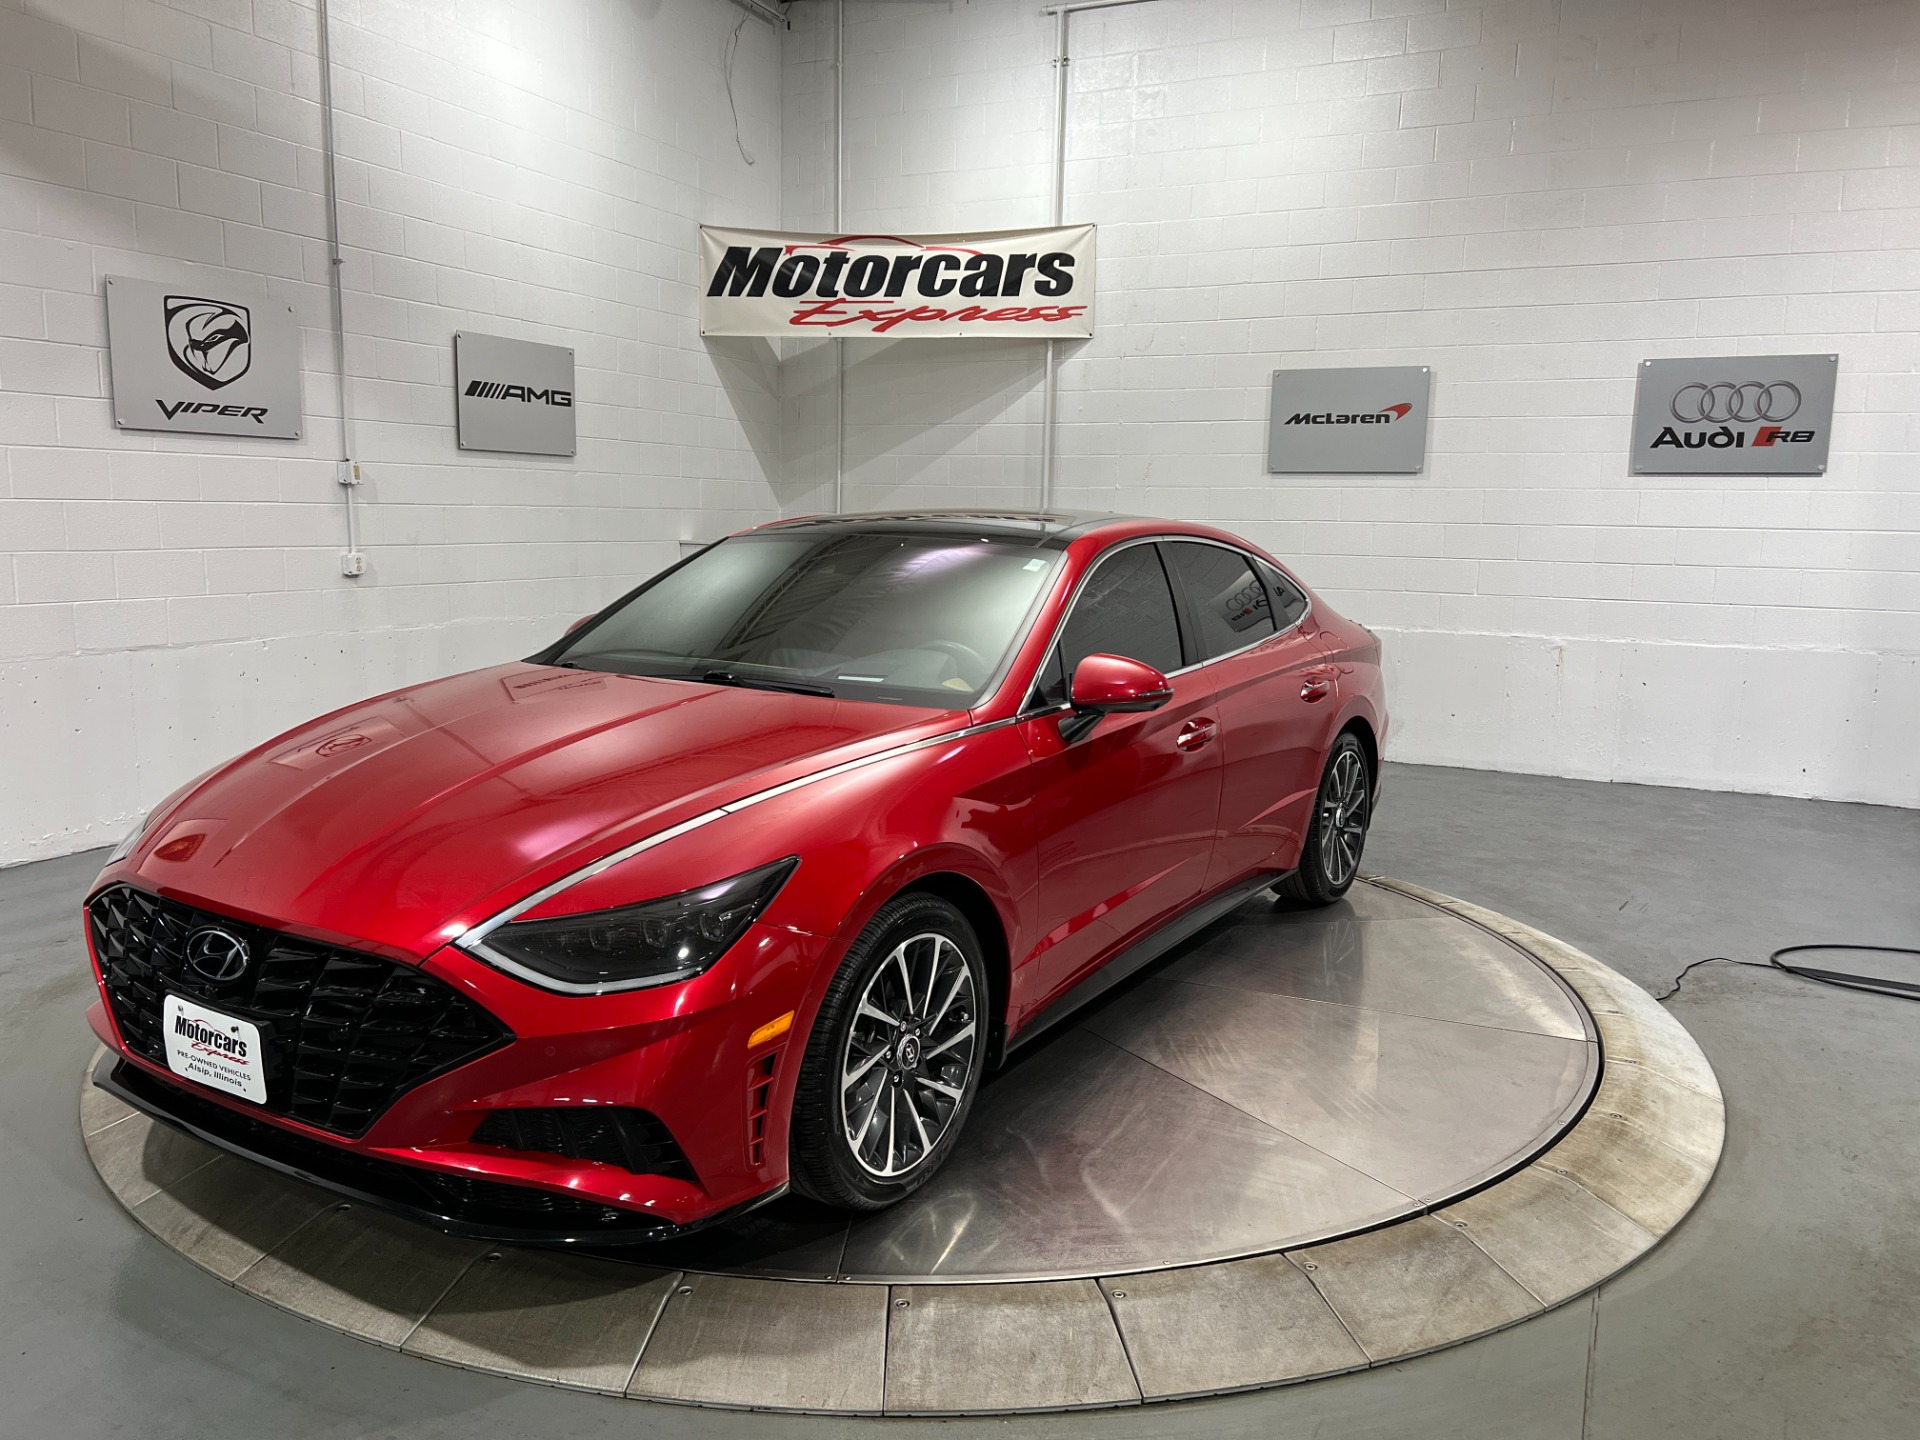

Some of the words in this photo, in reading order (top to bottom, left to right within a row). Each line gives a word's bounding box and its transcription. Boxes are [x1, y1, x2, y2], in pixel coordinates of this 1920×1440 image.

[706, 246, 1075, 297] Motorcars
[789, 298, 1088, 332] Express
[500, 384, 572, 407] AMG
[155, 399, 268, 424] VIPER
[1284, 412, 1390, 425] McLaren
[1650, 426, 1745, 448] Audi
[1765, 430, 1816, 443] R8
[175, 1015, 247, 1057] Motorcars
[177, 1049, 218, 1069] PRE-OWNED
[219, 1065, 251, 1081] VEHICLES
[191, 1040, 250, 1065] Express
[213, 1070, 242, 1087] Illinois
